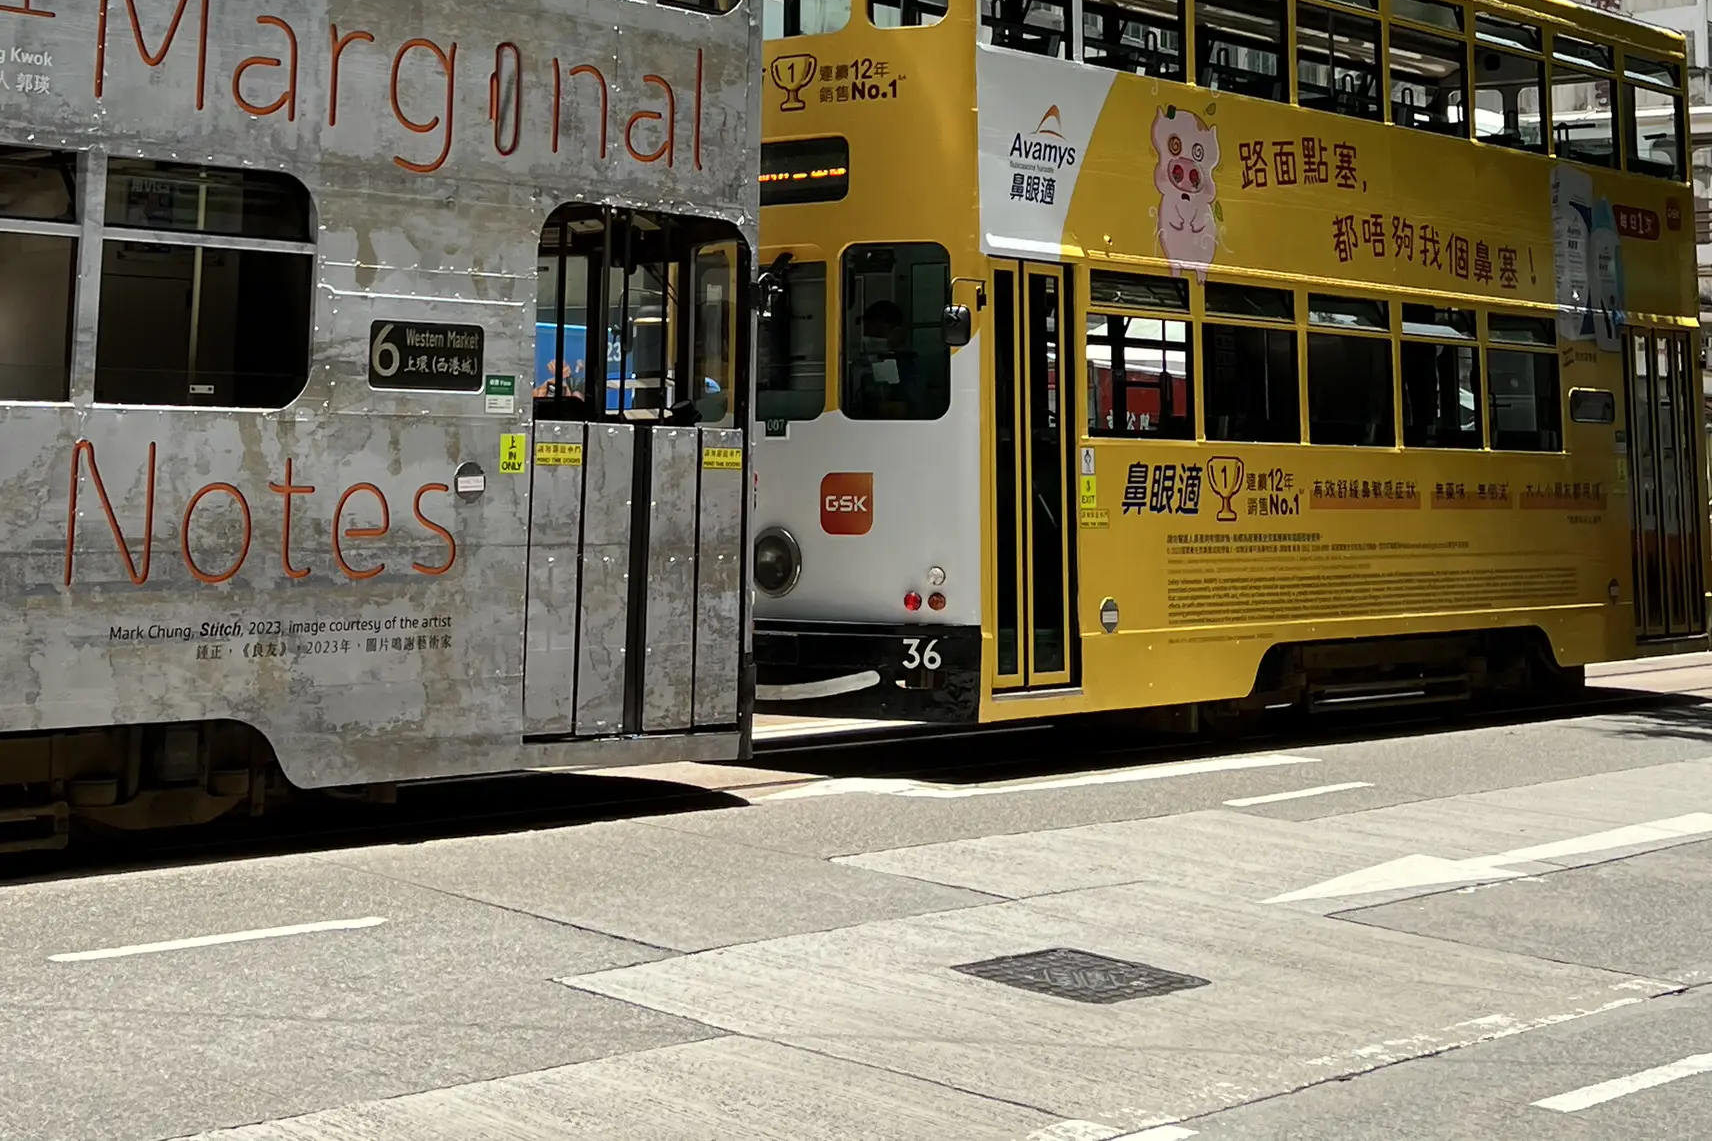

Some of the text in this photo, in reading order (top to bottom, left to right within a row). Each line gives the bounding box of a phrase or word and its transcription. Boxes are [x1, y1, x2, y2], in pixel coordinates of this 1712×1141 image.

[10, 46, 53, 67] Kwok
[1009, 132, 1076, 170] Avamys
[1009, 172, 1057, 205] 鼻眼適
[371, 323, 480, 377] 6 Western Market
[501, 460, 523, 471] ONLY
[825, 494, 868, 513] GSK
[1121, 460, 1204, 515] 鼻眼適
[63, 438, 458, 588] Notes
[109, 615, 453, 642] Mark Chung, Stitch, 2023, image courtesy of the artist
[902, 638, 942, 670] 36
